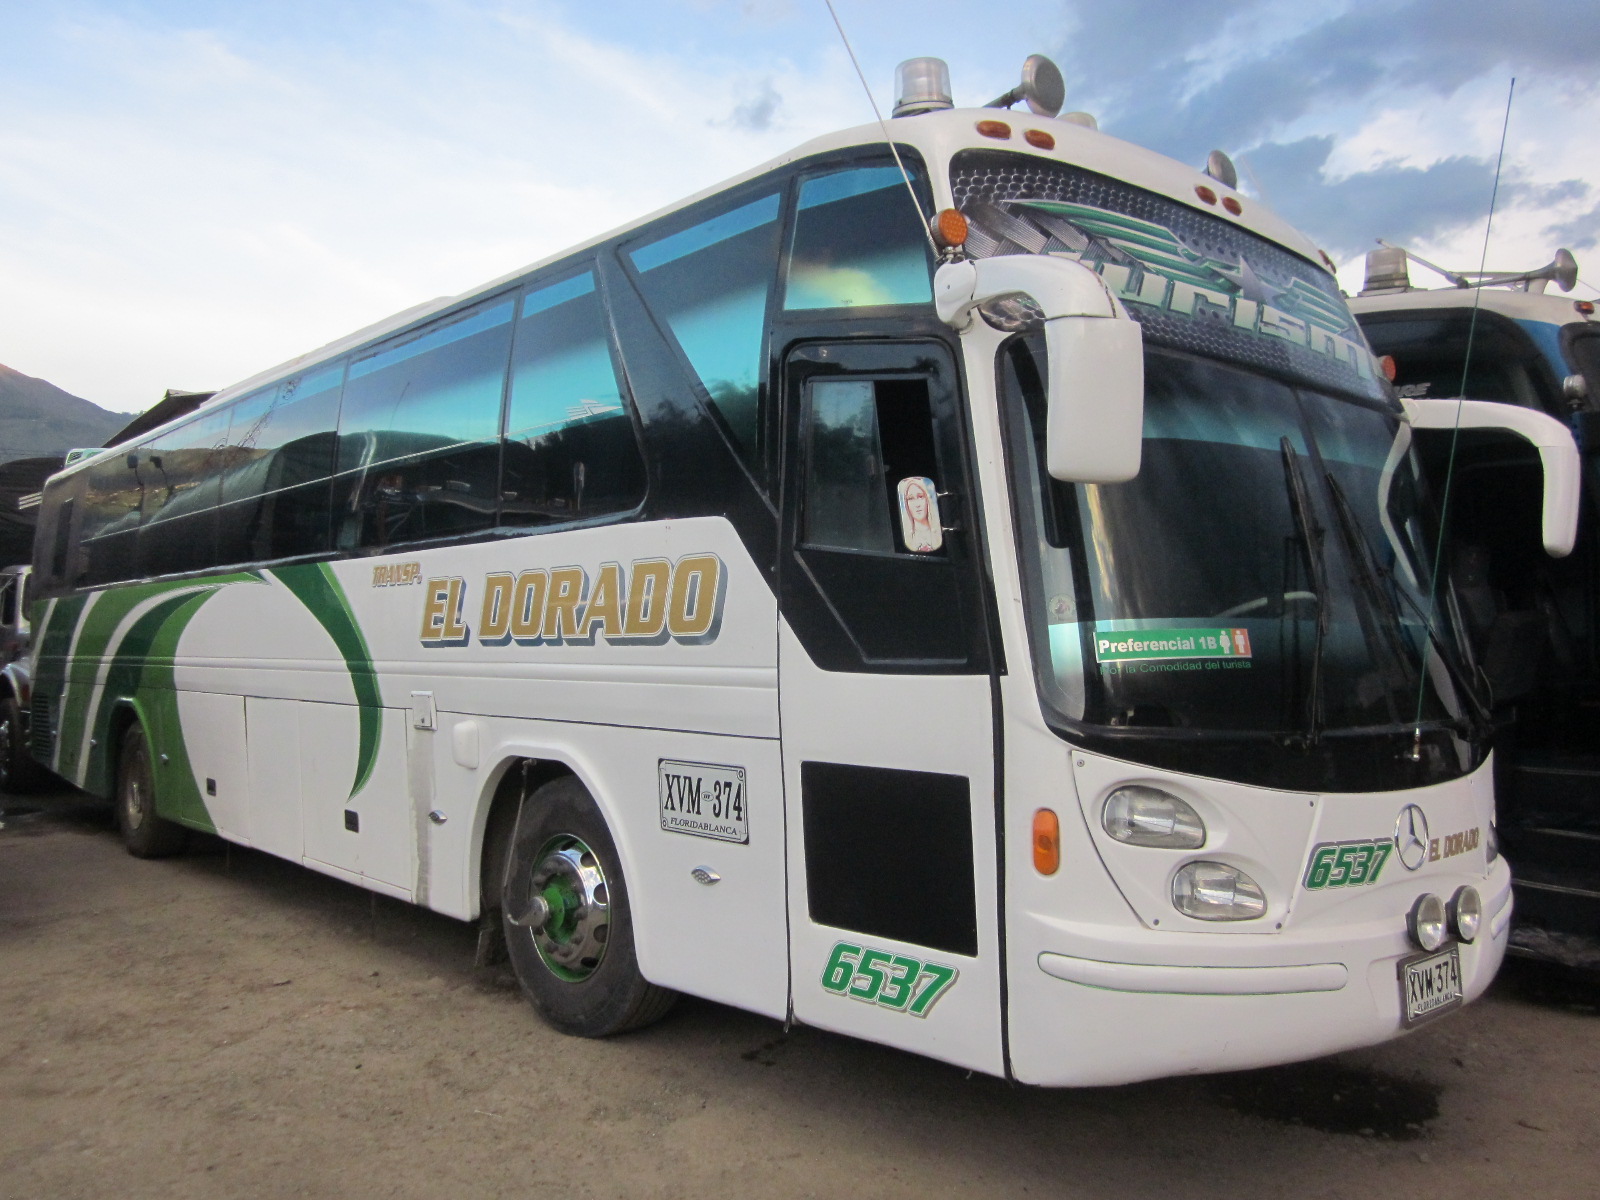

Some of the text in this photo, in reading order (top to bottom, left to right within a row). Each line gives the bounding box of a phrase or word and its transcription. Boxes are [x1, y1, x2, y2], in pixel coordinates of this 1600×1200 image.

[420, 552, 728, 648] EL DORADO
[1099, 636, 1217, 654] Preferencial 1B
[1125, 664, 1136, 674] la
[1140, 661, 1202, 673] Comodidad
[1205, 660, 1220, 669] del
[1223, 660, 1252, 669] turista
[664, 773, 742, 821] XVM 374
[670, 817, 737, 836] FLORIDABLANCA
[1428, 826, 1479, 862] EL DORADO
[1302, 837, 1393, 891] 6537
[820, 940, 960, 1019] 6537
[1409, 955, 1458, 1003] XVM 374
